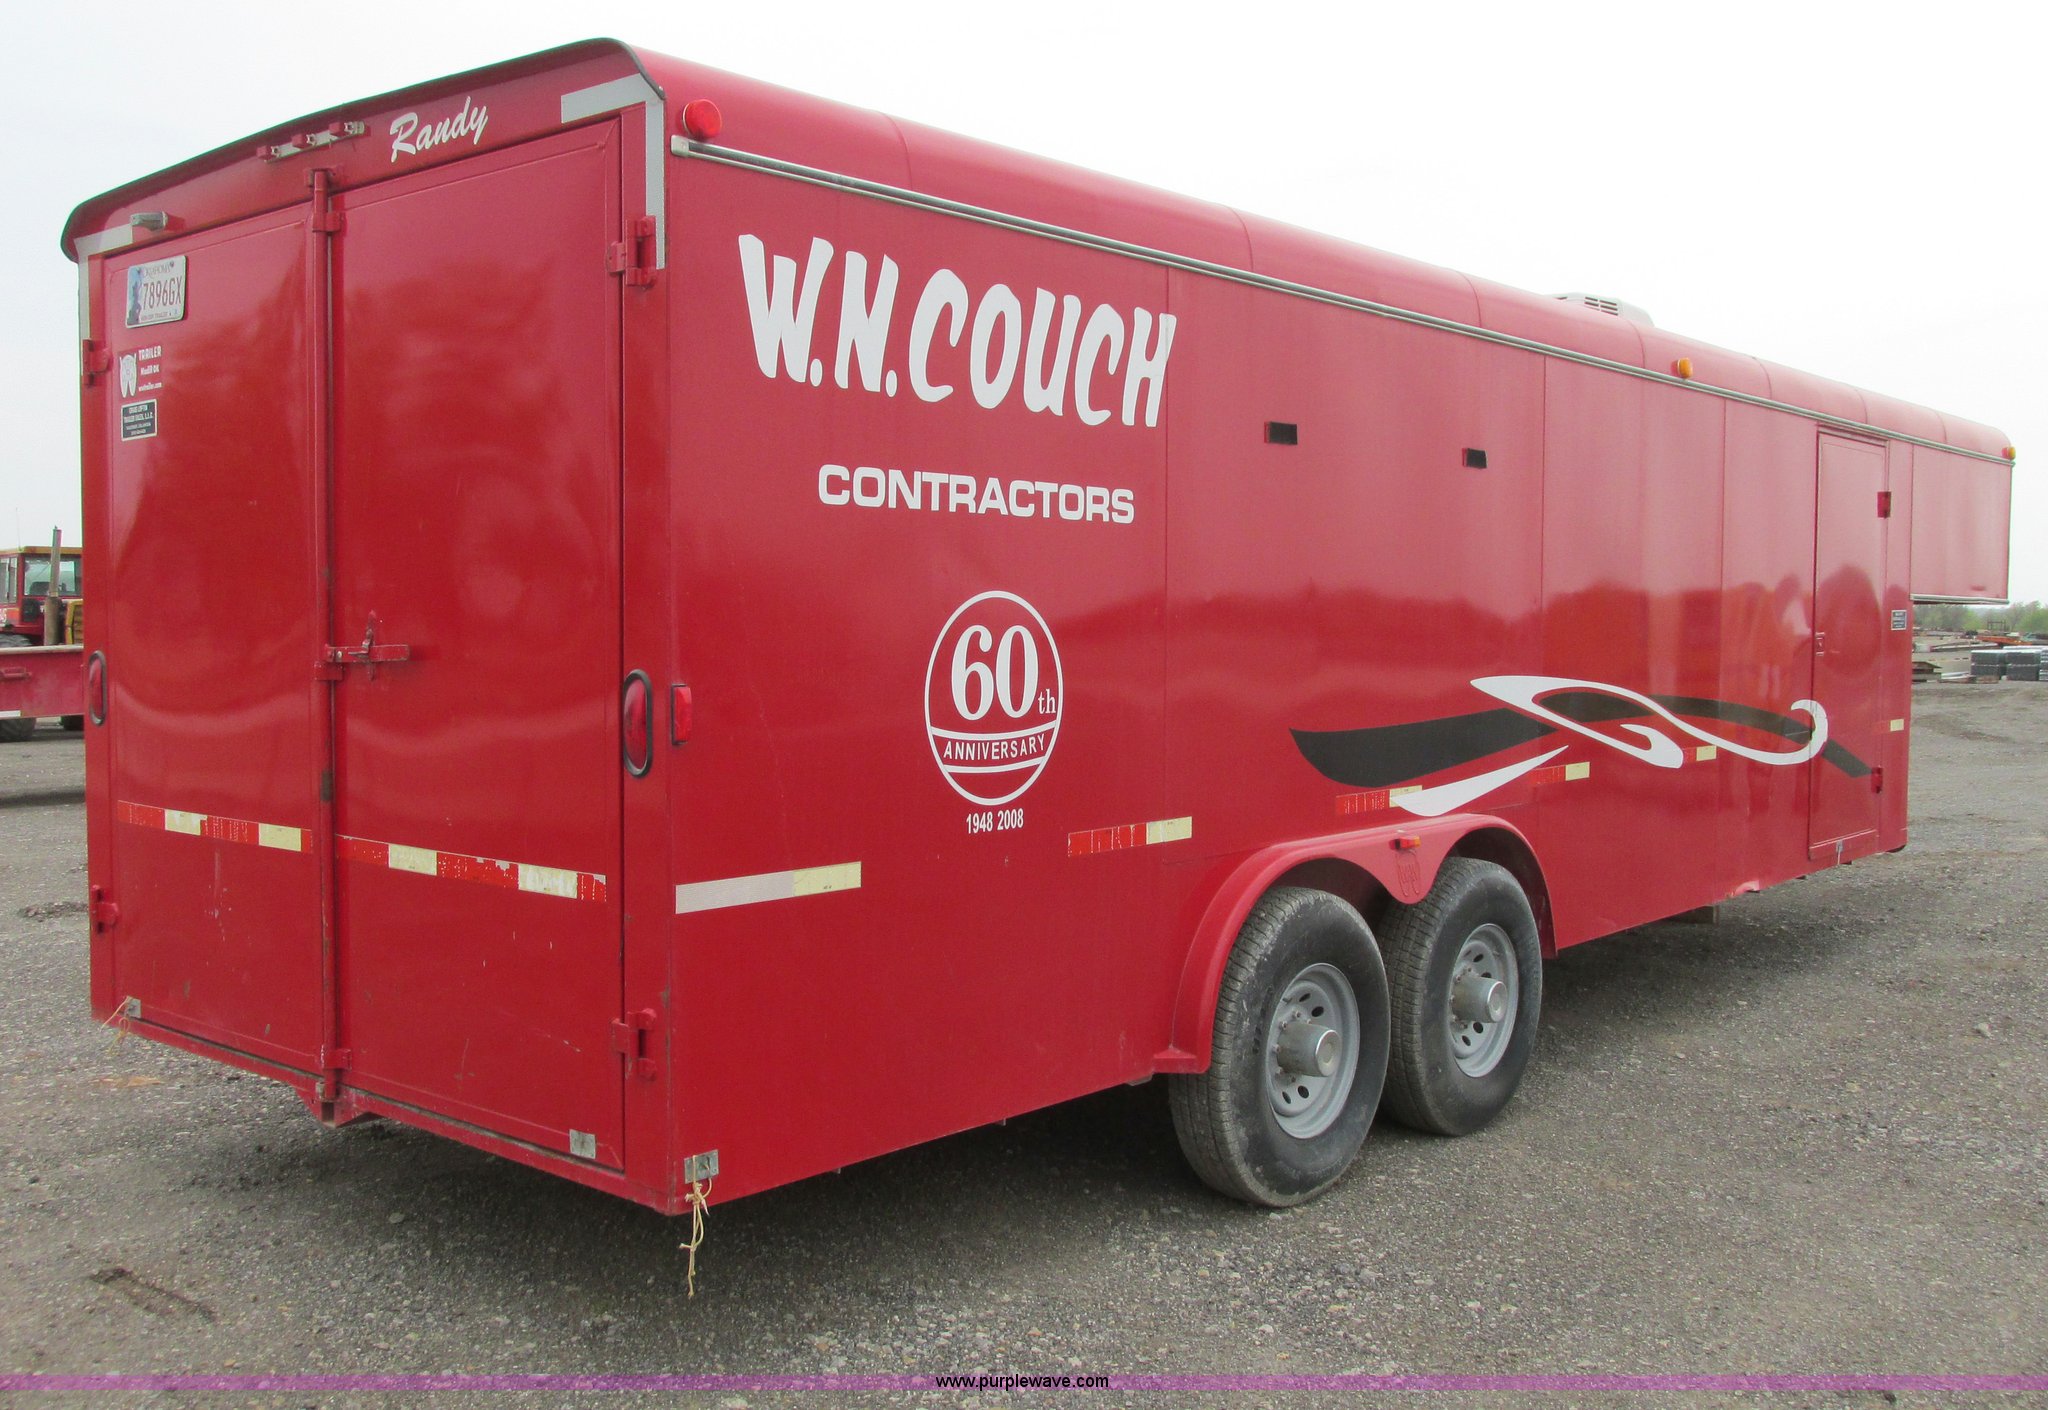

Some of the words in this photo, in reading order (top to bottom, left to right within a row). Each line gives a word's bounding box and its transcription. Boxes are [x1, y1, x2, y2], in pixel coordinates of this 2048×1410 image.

[389, 95, 489, 163] Randy
[143, 276, 182, 310] 7896GX
[818, 464, 1135, 524] CONTRACTORS
[951, 624, 1057, 721] 60th
[943, 733, 1046, 761] ANNIVERSARY
[966, 810, 993, 834] 1948
[997, 807, 1024, 831] 2008
